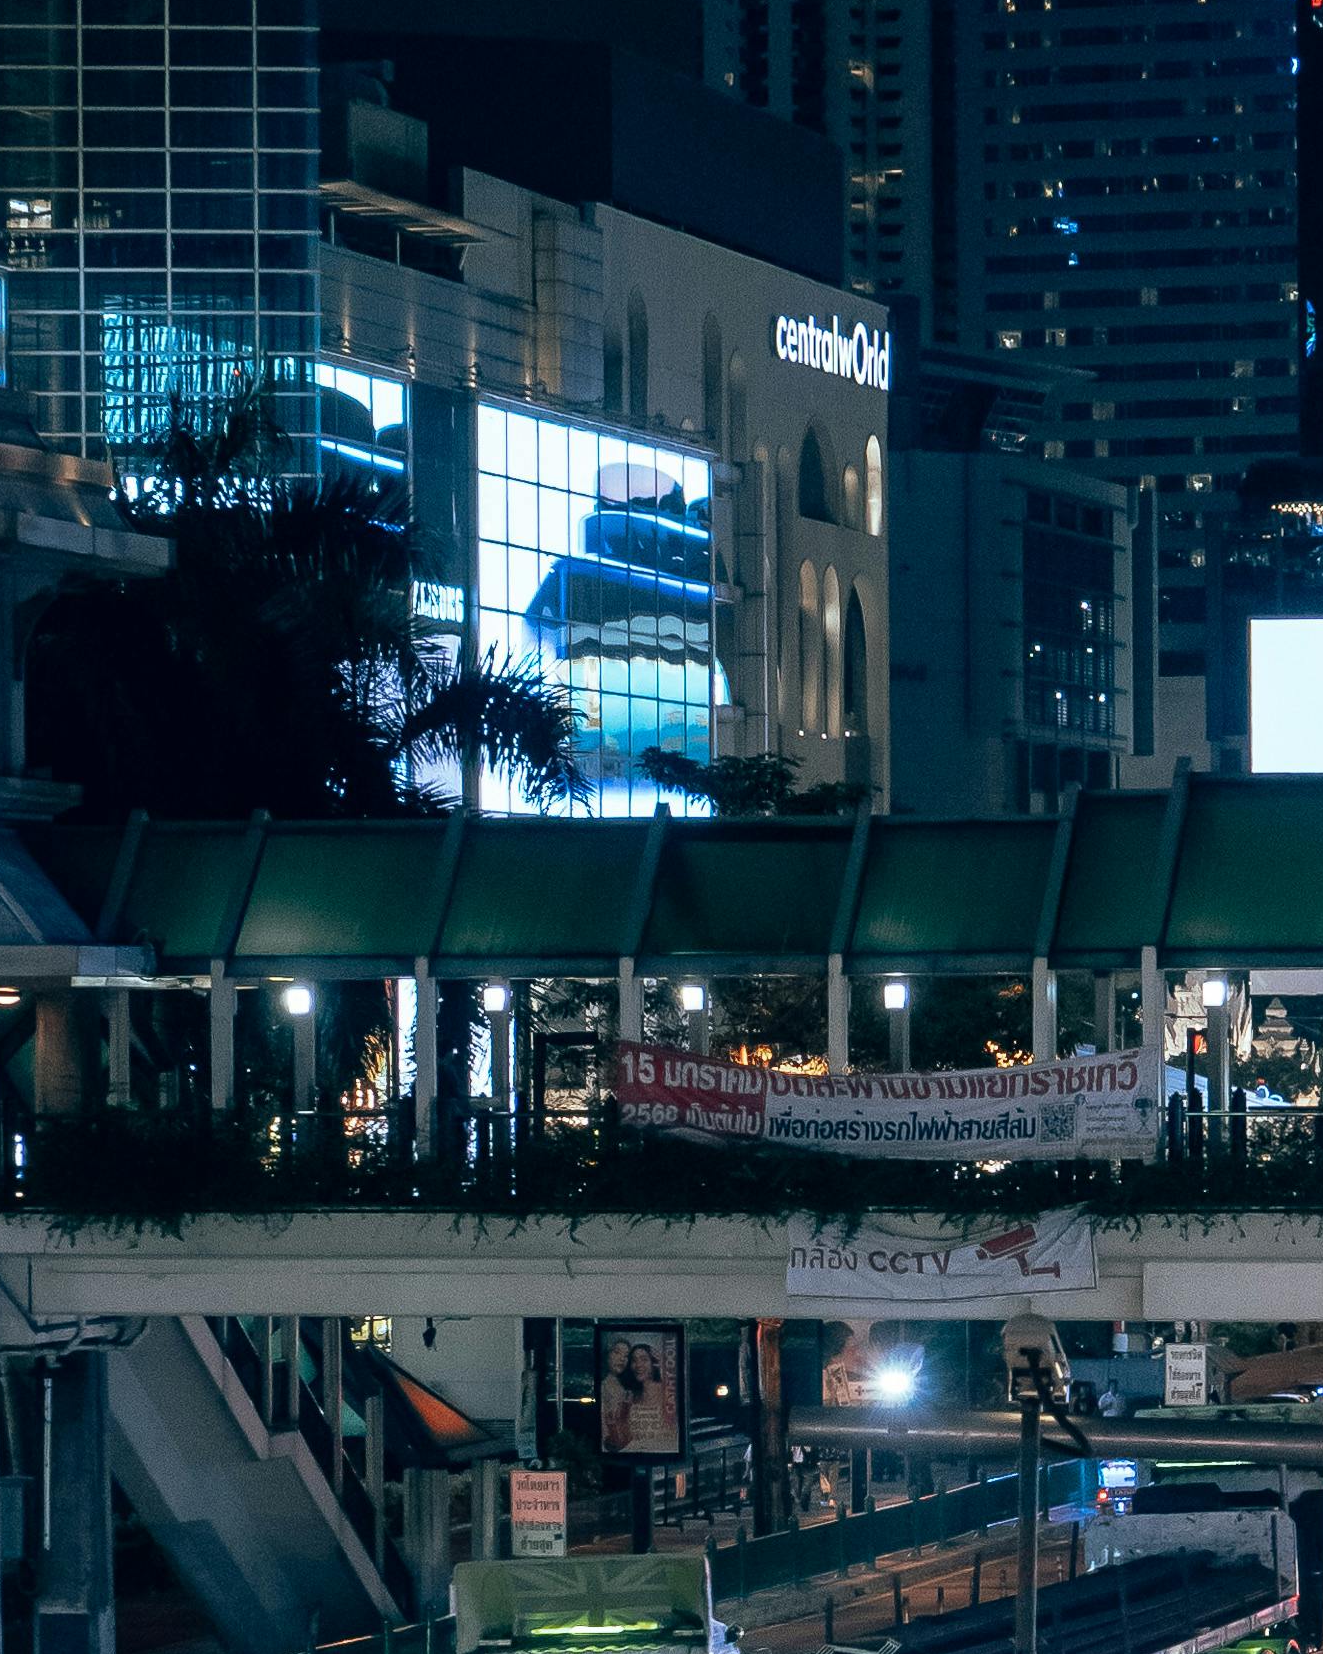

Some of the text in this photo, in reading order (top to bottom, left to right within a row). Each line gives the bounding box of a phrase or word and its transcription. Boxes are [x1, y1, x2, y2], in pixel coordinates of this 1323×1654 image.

[621, 1050, 764, 1094] 15 มกราคม
[867, 1248, 953, 1276] CCTV
